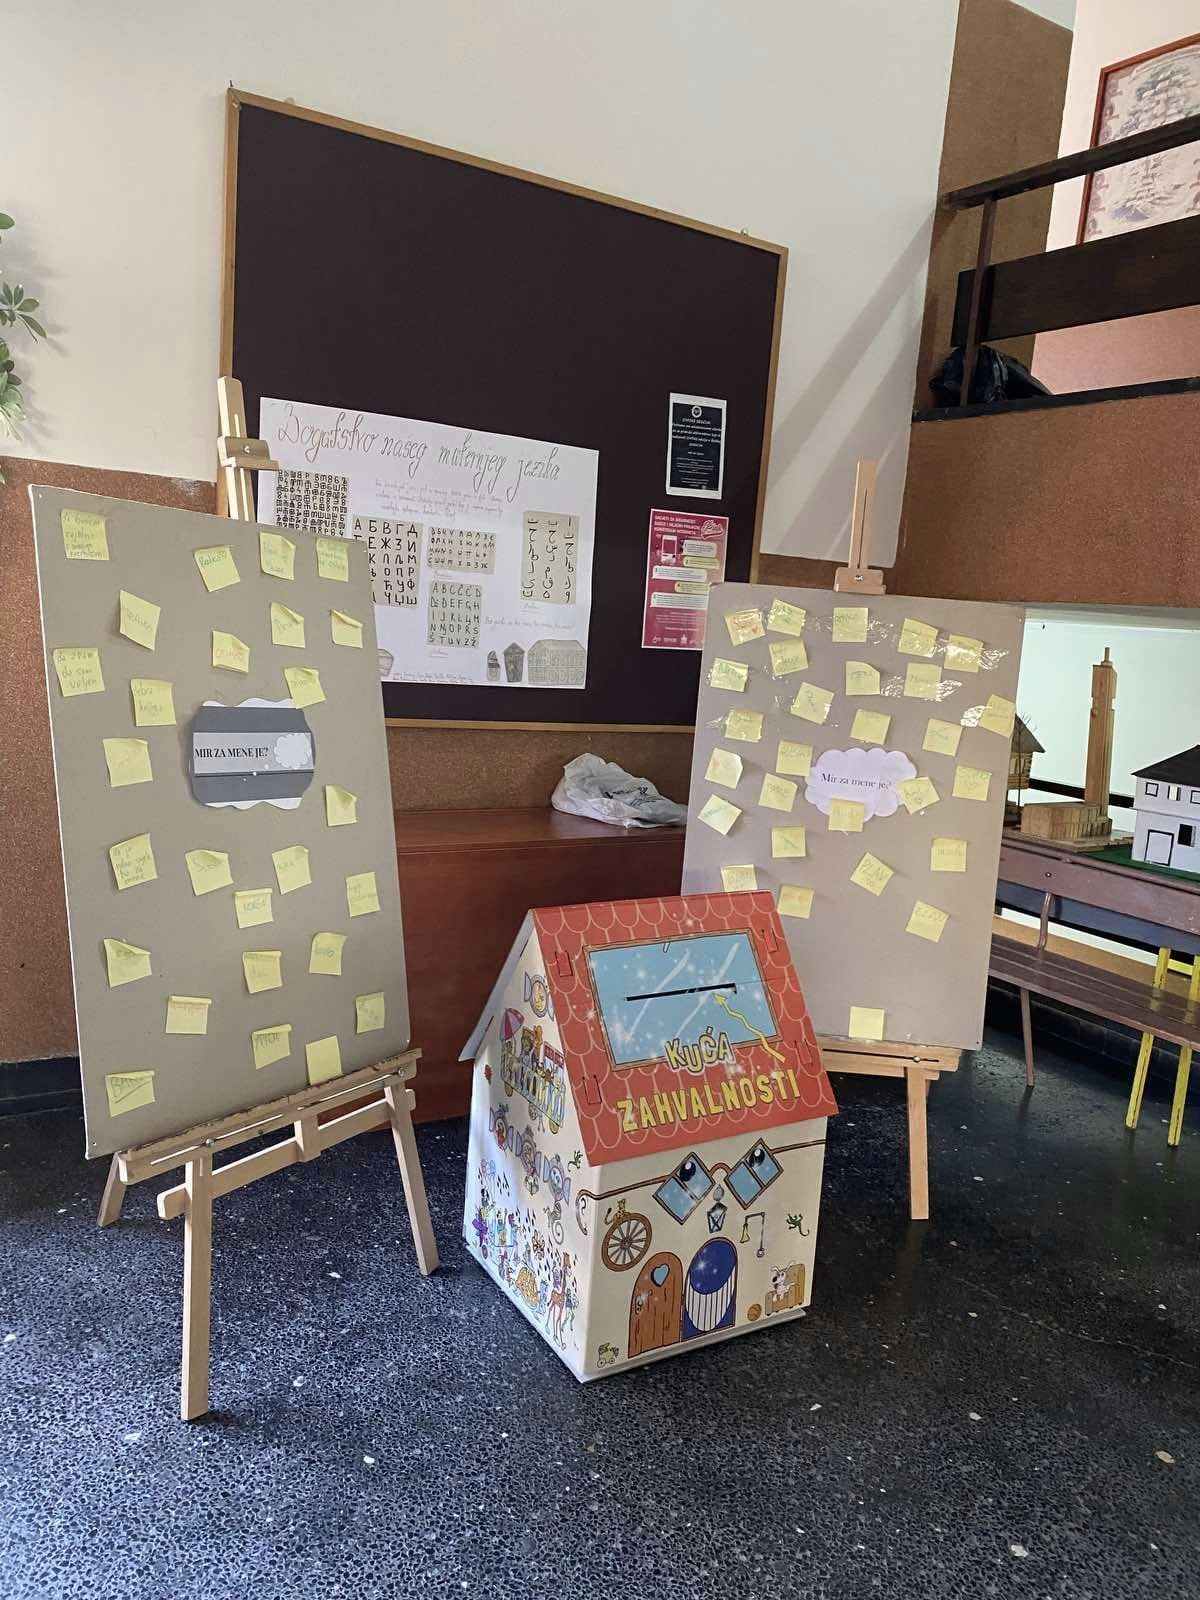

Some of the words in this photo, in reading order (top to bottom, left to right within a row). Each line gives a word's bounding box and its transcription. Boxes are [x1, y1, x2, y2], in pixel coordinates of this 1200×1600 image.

[195, 748, 212, 758] MIR
[214, 748, 226, 758] ZA
[227, 748, 255, 758] MENE
[255, 747, 268, 758] JE?
[820, 773, 836, 783] Mir
[852, 778, 876, 788] mene
[665, 1026, 735, 1074] KUĆA
[617, 1069, 801, 1133] ZAHVALNOSTI
